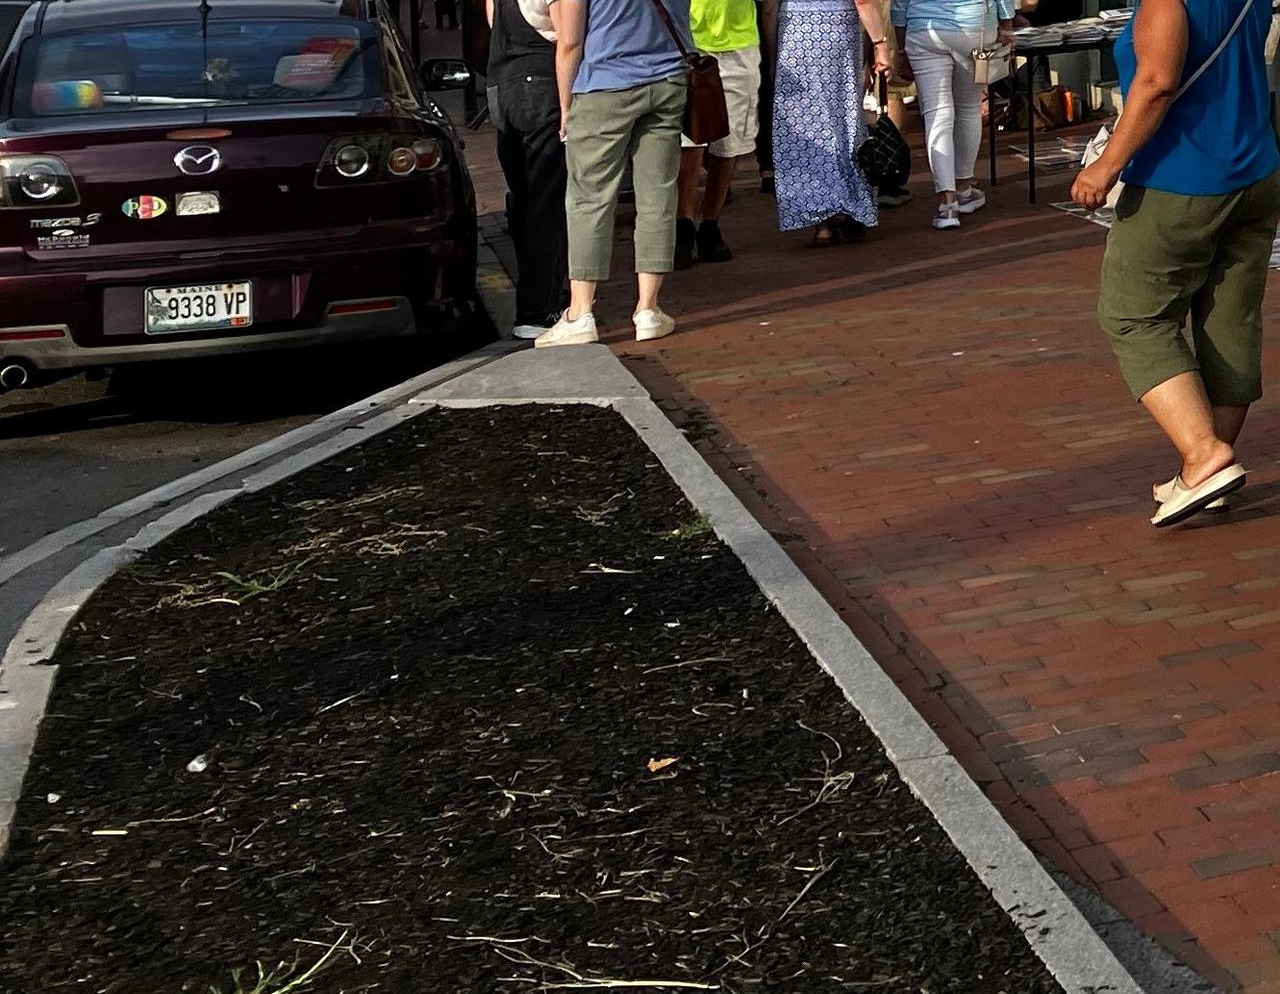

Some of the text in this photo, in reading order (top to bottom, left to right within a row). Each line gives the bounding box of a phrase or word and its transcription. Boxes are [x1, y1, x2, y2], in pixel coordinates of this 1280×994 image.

[176, 285, 223, 295] MAINE
[168, 291, 247, 320] 9338 VP
